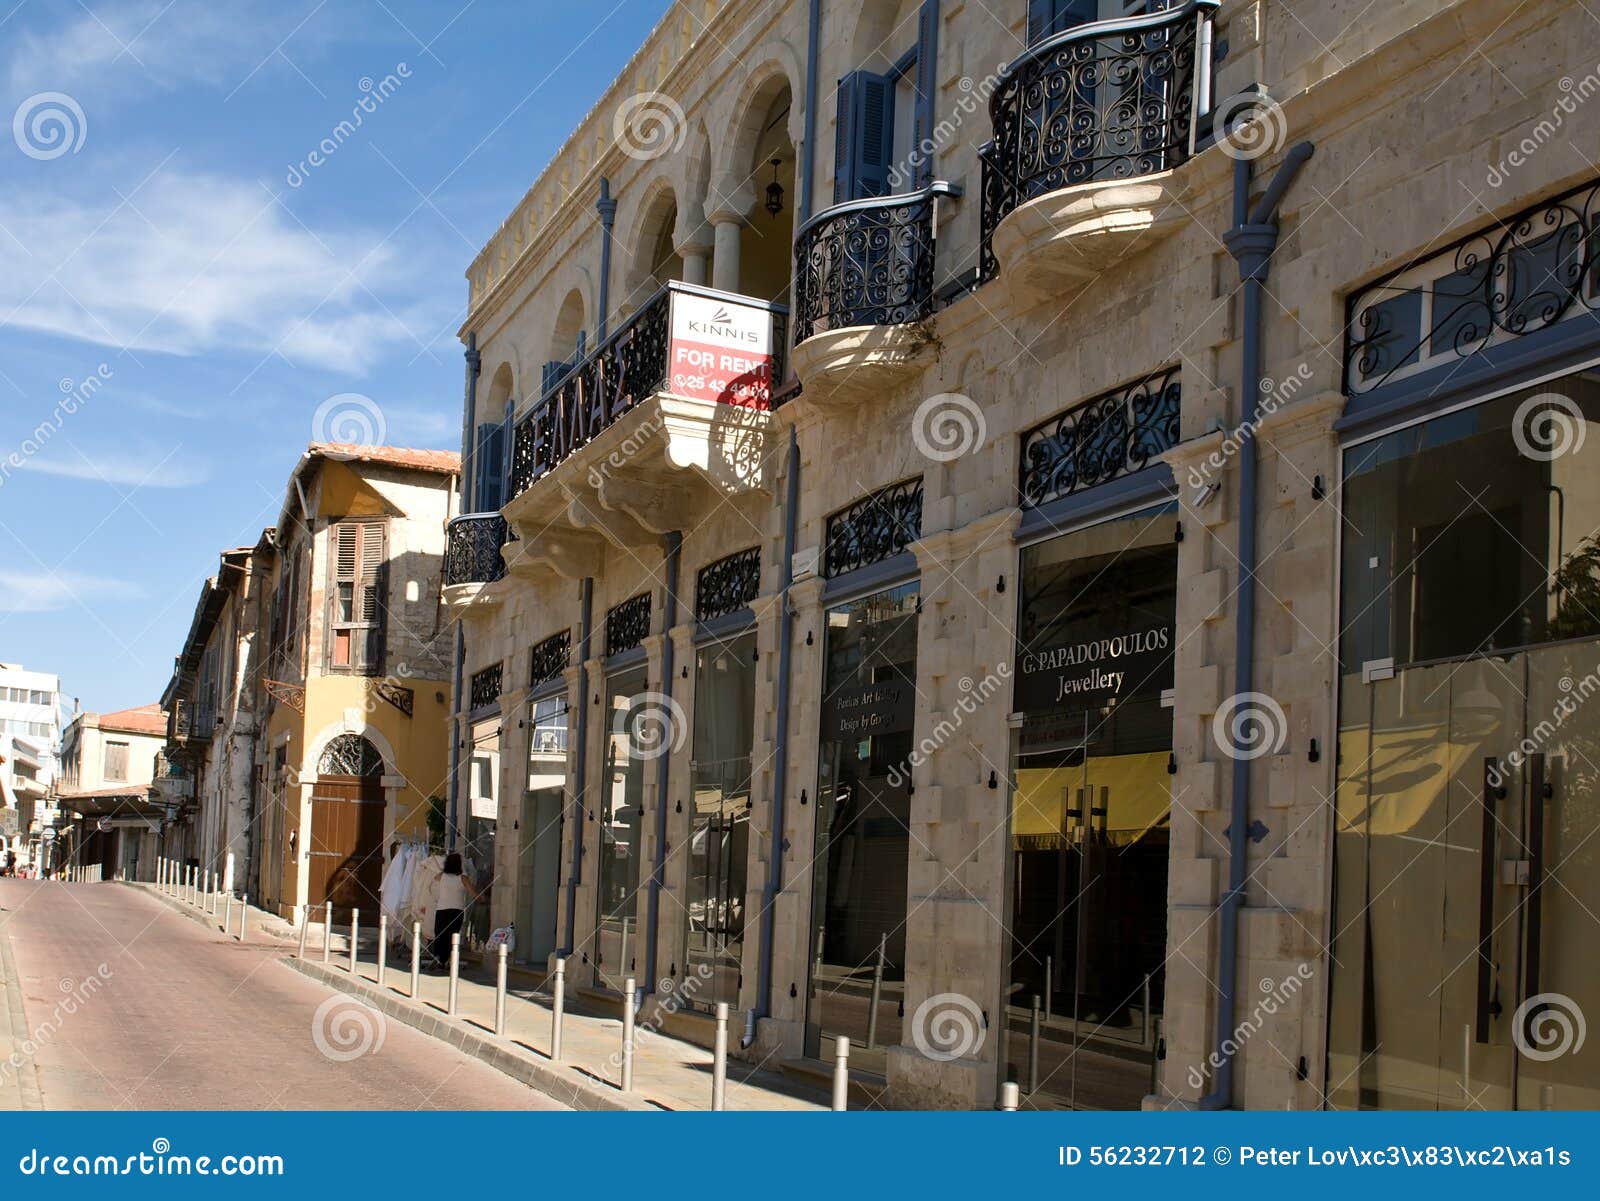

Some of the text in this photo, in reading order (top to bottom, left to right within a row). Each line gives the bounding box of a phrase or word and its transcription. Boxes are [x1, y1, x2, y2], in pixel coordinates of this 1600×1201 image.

[689, 320, 758, 343] KINNIS
[677, 348, 768, 377] FOR RENT
[687, 376, 705, 389] 25
[1039, 627, 1169, 671] PAPADOPOULOS
[1056, 668, 1125, 702] Jewellery
[861, 692, 873, 705] Art
[861, 714, 870, 731] by
